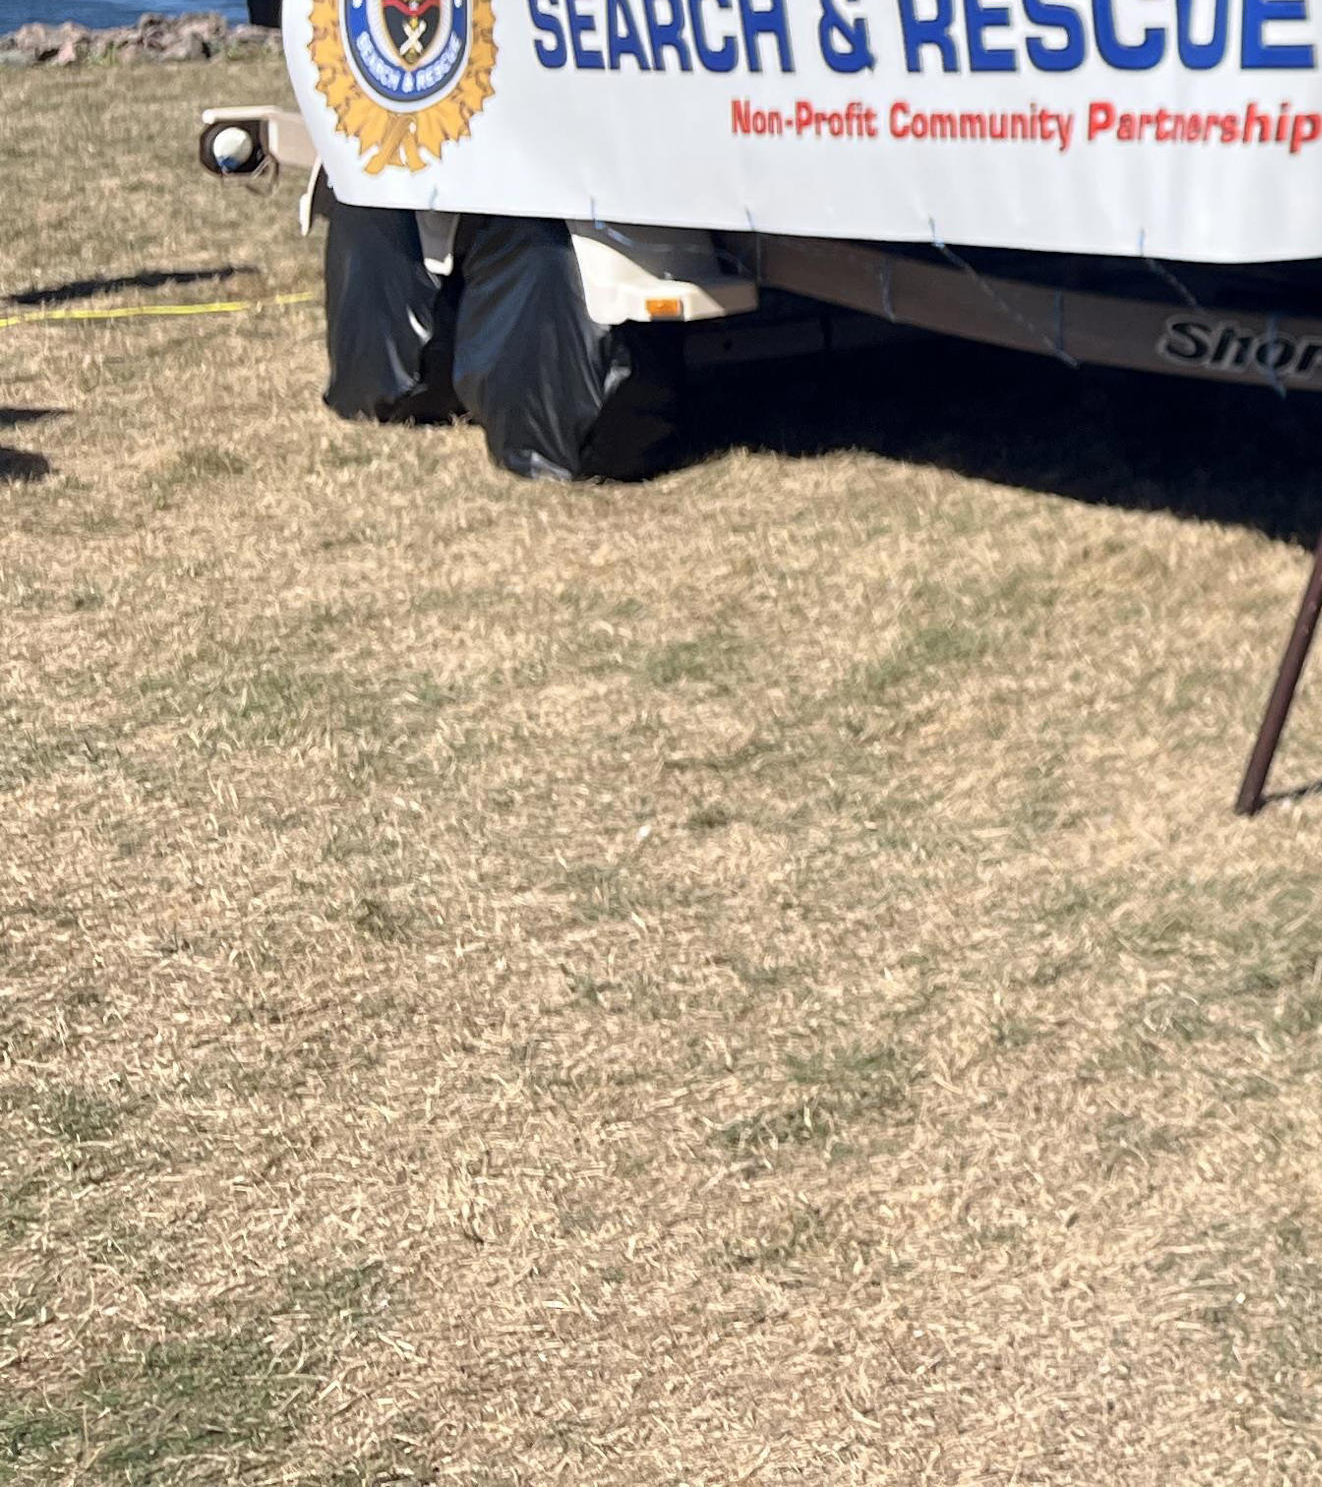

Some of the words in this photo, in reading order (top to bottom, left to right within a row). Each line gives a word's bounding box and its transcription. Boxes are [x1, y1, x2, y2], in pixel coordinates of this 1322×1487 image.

[730, 98, 878, 138] Non-Profit
[888, 101, 1073, 152] Community
[1087, 100, 1322, 155] Partnership
